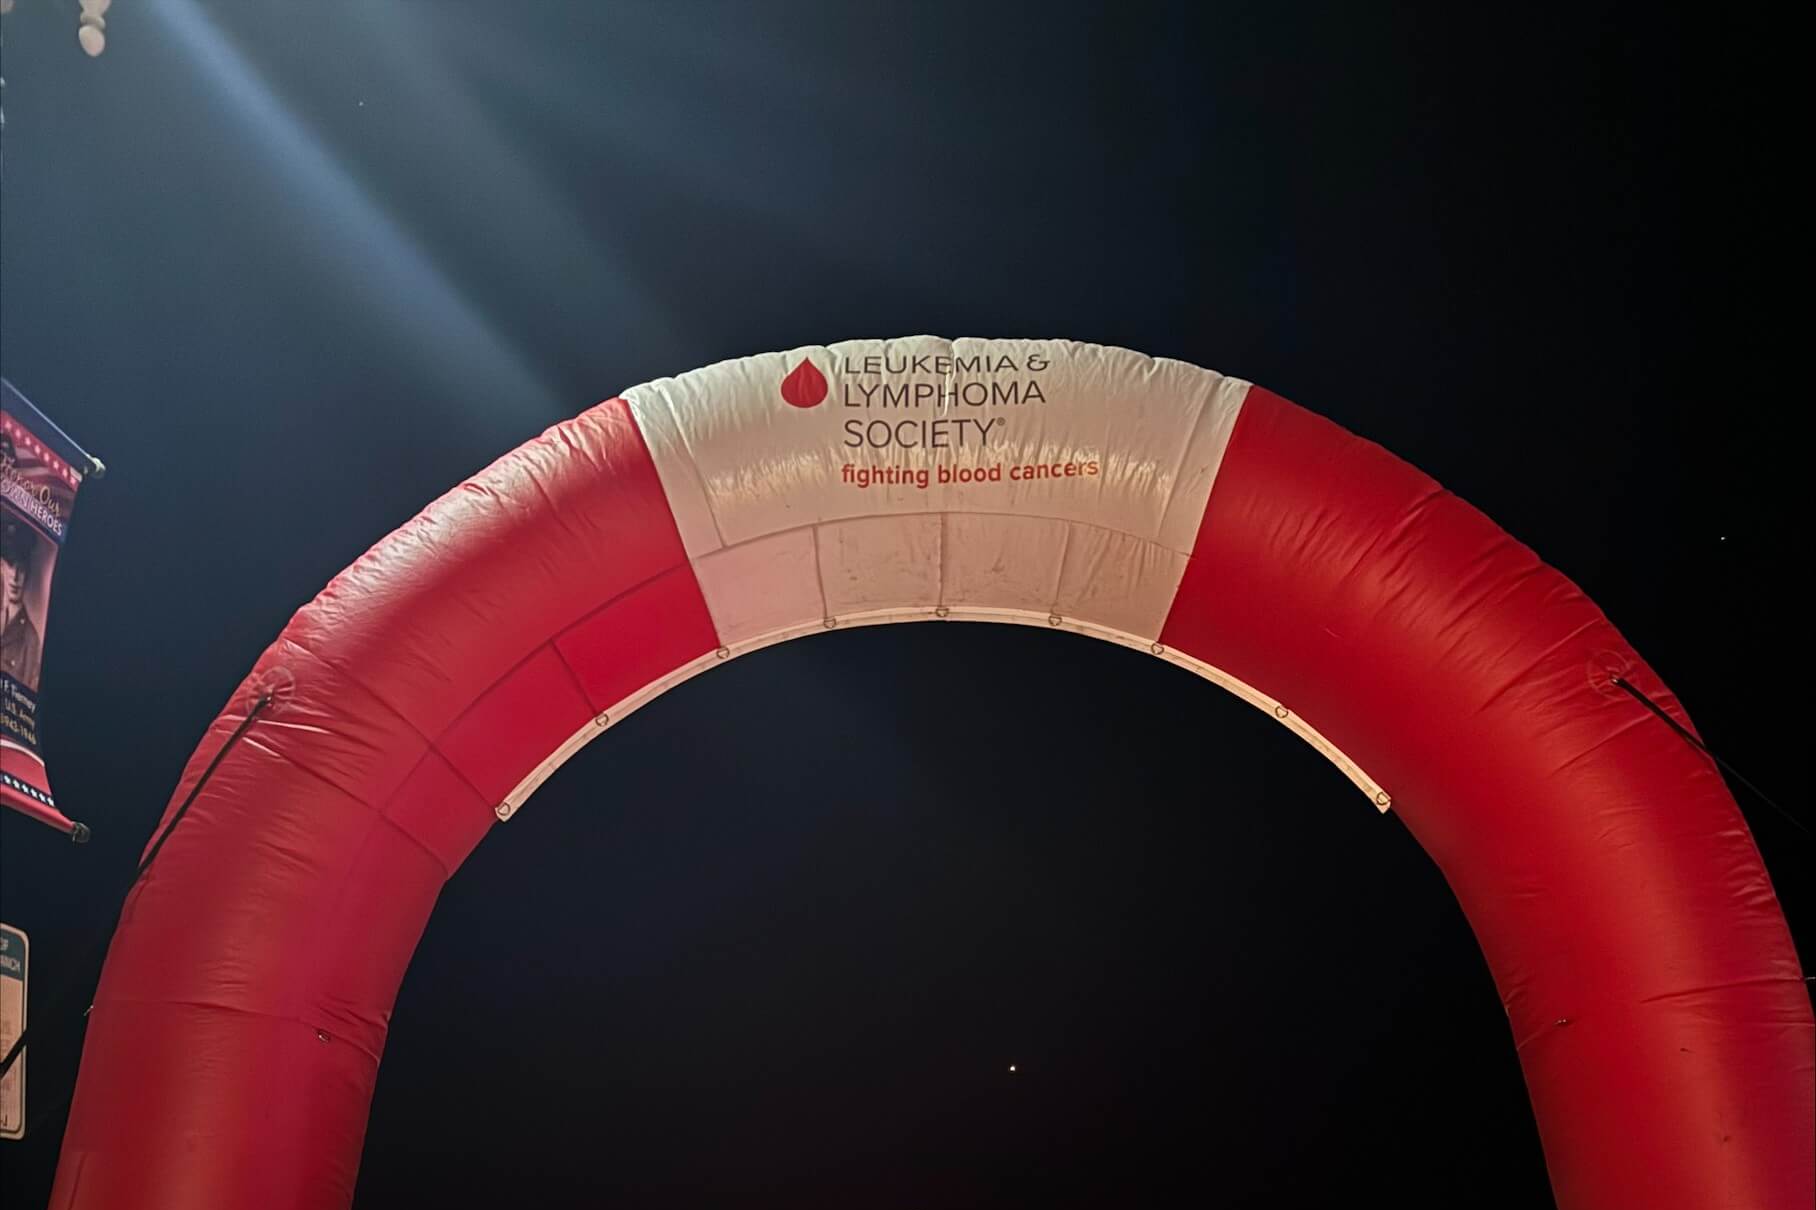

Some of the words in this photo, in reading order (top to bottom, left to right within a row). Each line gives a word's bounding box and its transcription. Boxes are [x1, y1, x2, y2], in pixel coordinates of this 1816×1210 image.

[845, 354, 1018, 375] LEUKEMIA
[1026, 354, 1050, 372] &
[845, 380, 1047, 408] LYMPHOMA
[841, 464, 929, 489] fighting
[938, 463, 1001, 484] blood
[1010, 460, 1099, 482] cancers
[31, 500, 63, 537] HEROES
